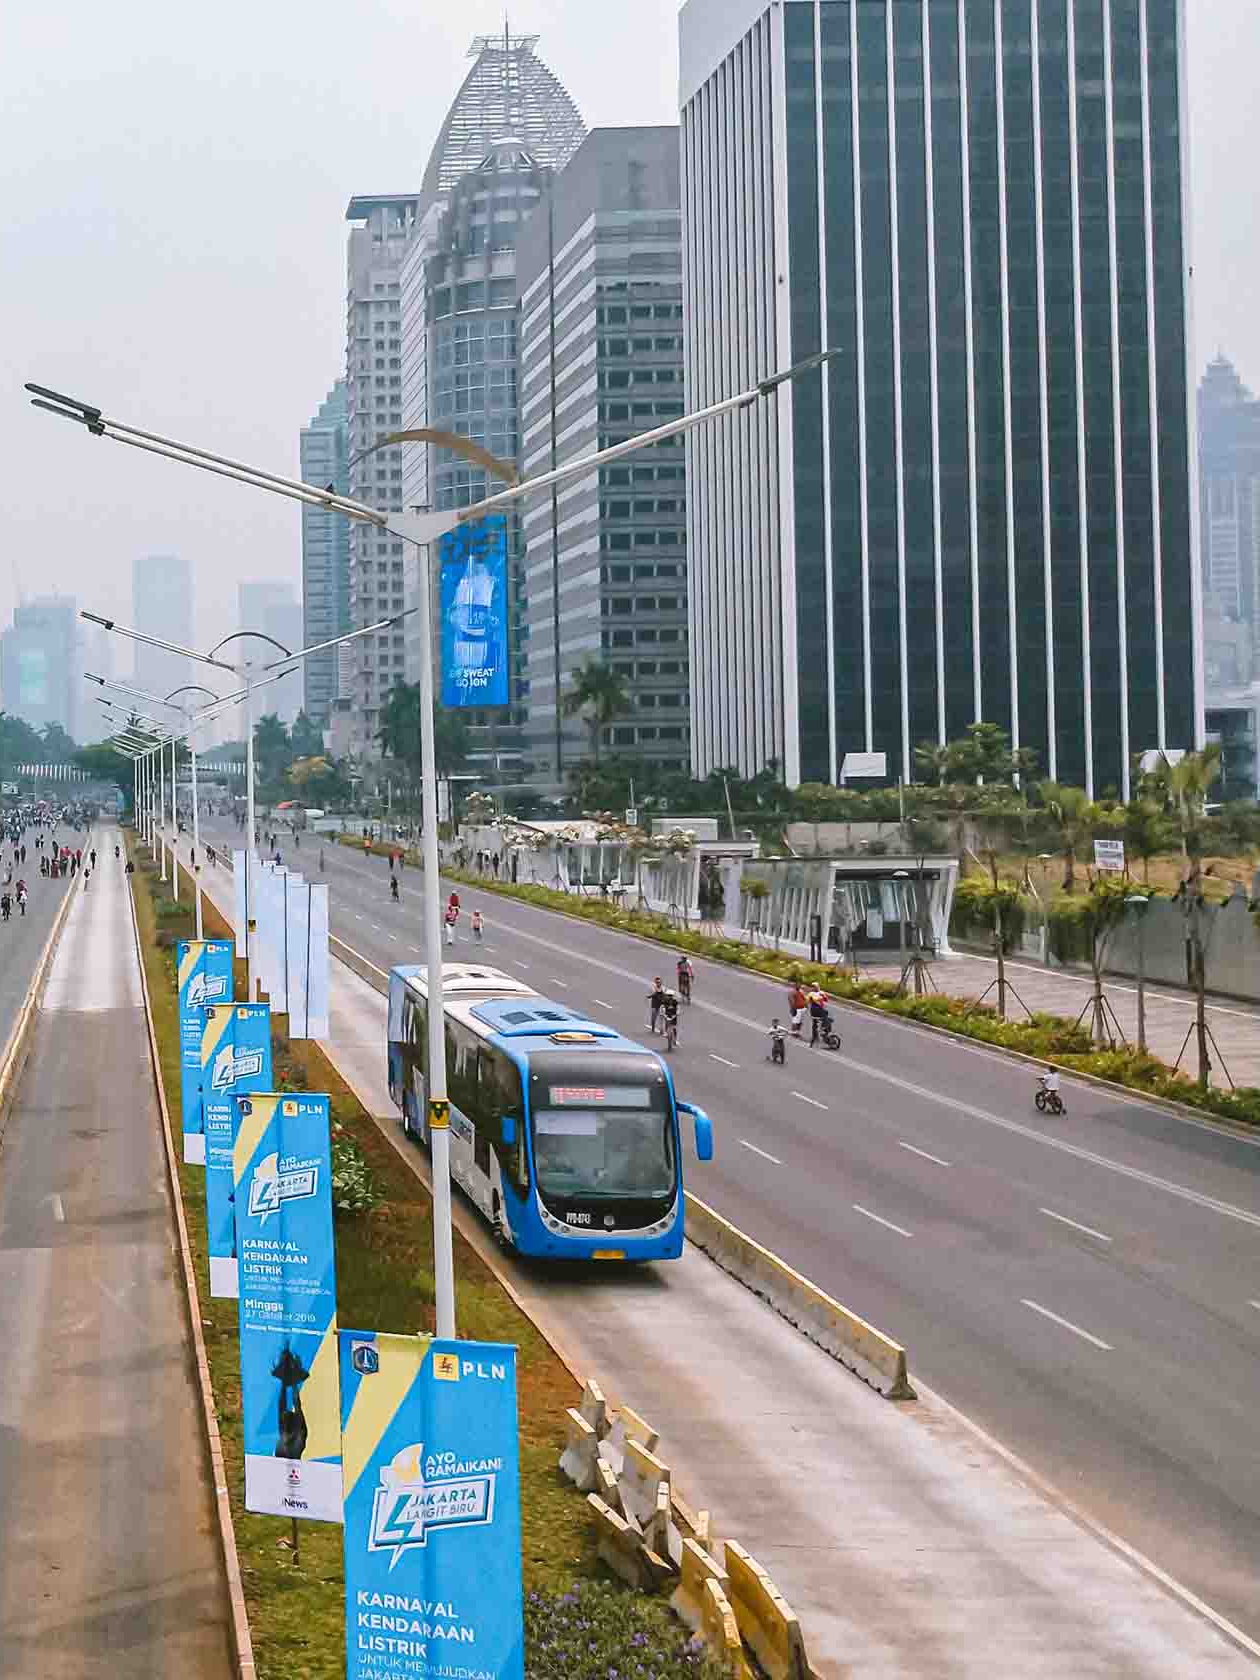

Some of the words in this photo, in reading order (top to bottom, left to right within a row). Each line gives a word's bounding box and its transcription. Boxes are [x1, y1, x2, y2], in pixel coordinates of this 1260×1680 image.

[463, 667, 495, 678] SWEAT
[299, 1103, 323, 1114] PLN
[243, 1239, 300, 1251] KARNAVAL
[243, 1251, 308, 1264] KENDARAAN
[244, 1264, 283, 1275] LISTRIK
[244, 1299, 283, 1312] Minggu
[462, 1361, 505, 1380] PLN
[426, 1451, 456, 1467] AYO
[410, 1488, 477, 1507] JAKARTA
[450, 1503, 475, 1515] BIRU
[356, 1590, 459, 1618] KARNAVAL
[357, 1612, 475, 1643] KENDARAAN
[358, 1633, 427, 1658] LISTRIK
[357, 1653, 402, 1669] UNTUK
